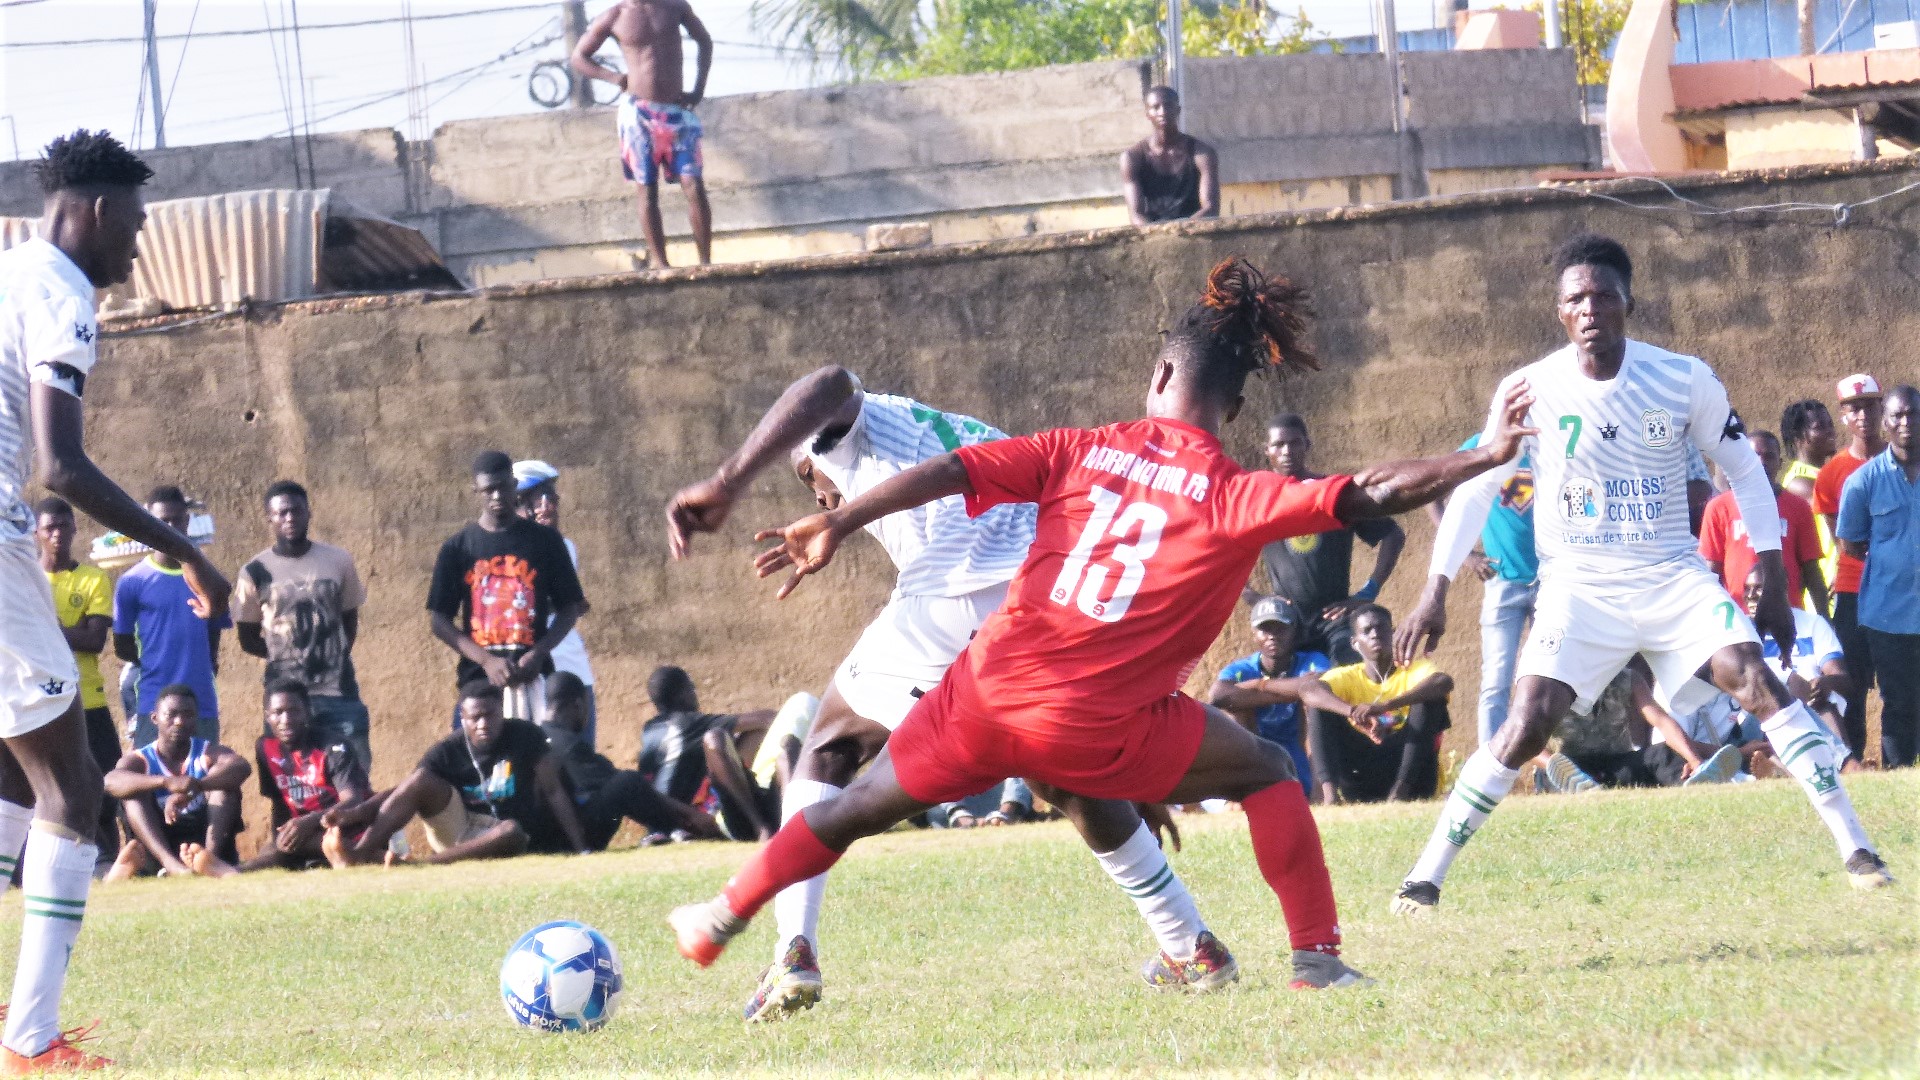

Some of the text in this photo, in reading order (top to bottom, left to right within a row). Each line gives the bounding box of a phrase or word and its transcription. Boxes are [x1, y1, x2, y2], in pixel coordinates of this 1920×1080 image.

[1559, 415, 1583, 459] 7
[1606, 475, 1666, 498] MOUSSE
[1608, 501, 1664, 522] CONFOR
[1603, 531, 1614, 543] de
[1049, 485, 1168, 623] 13
[1712, 601, 1735, 630] 7
